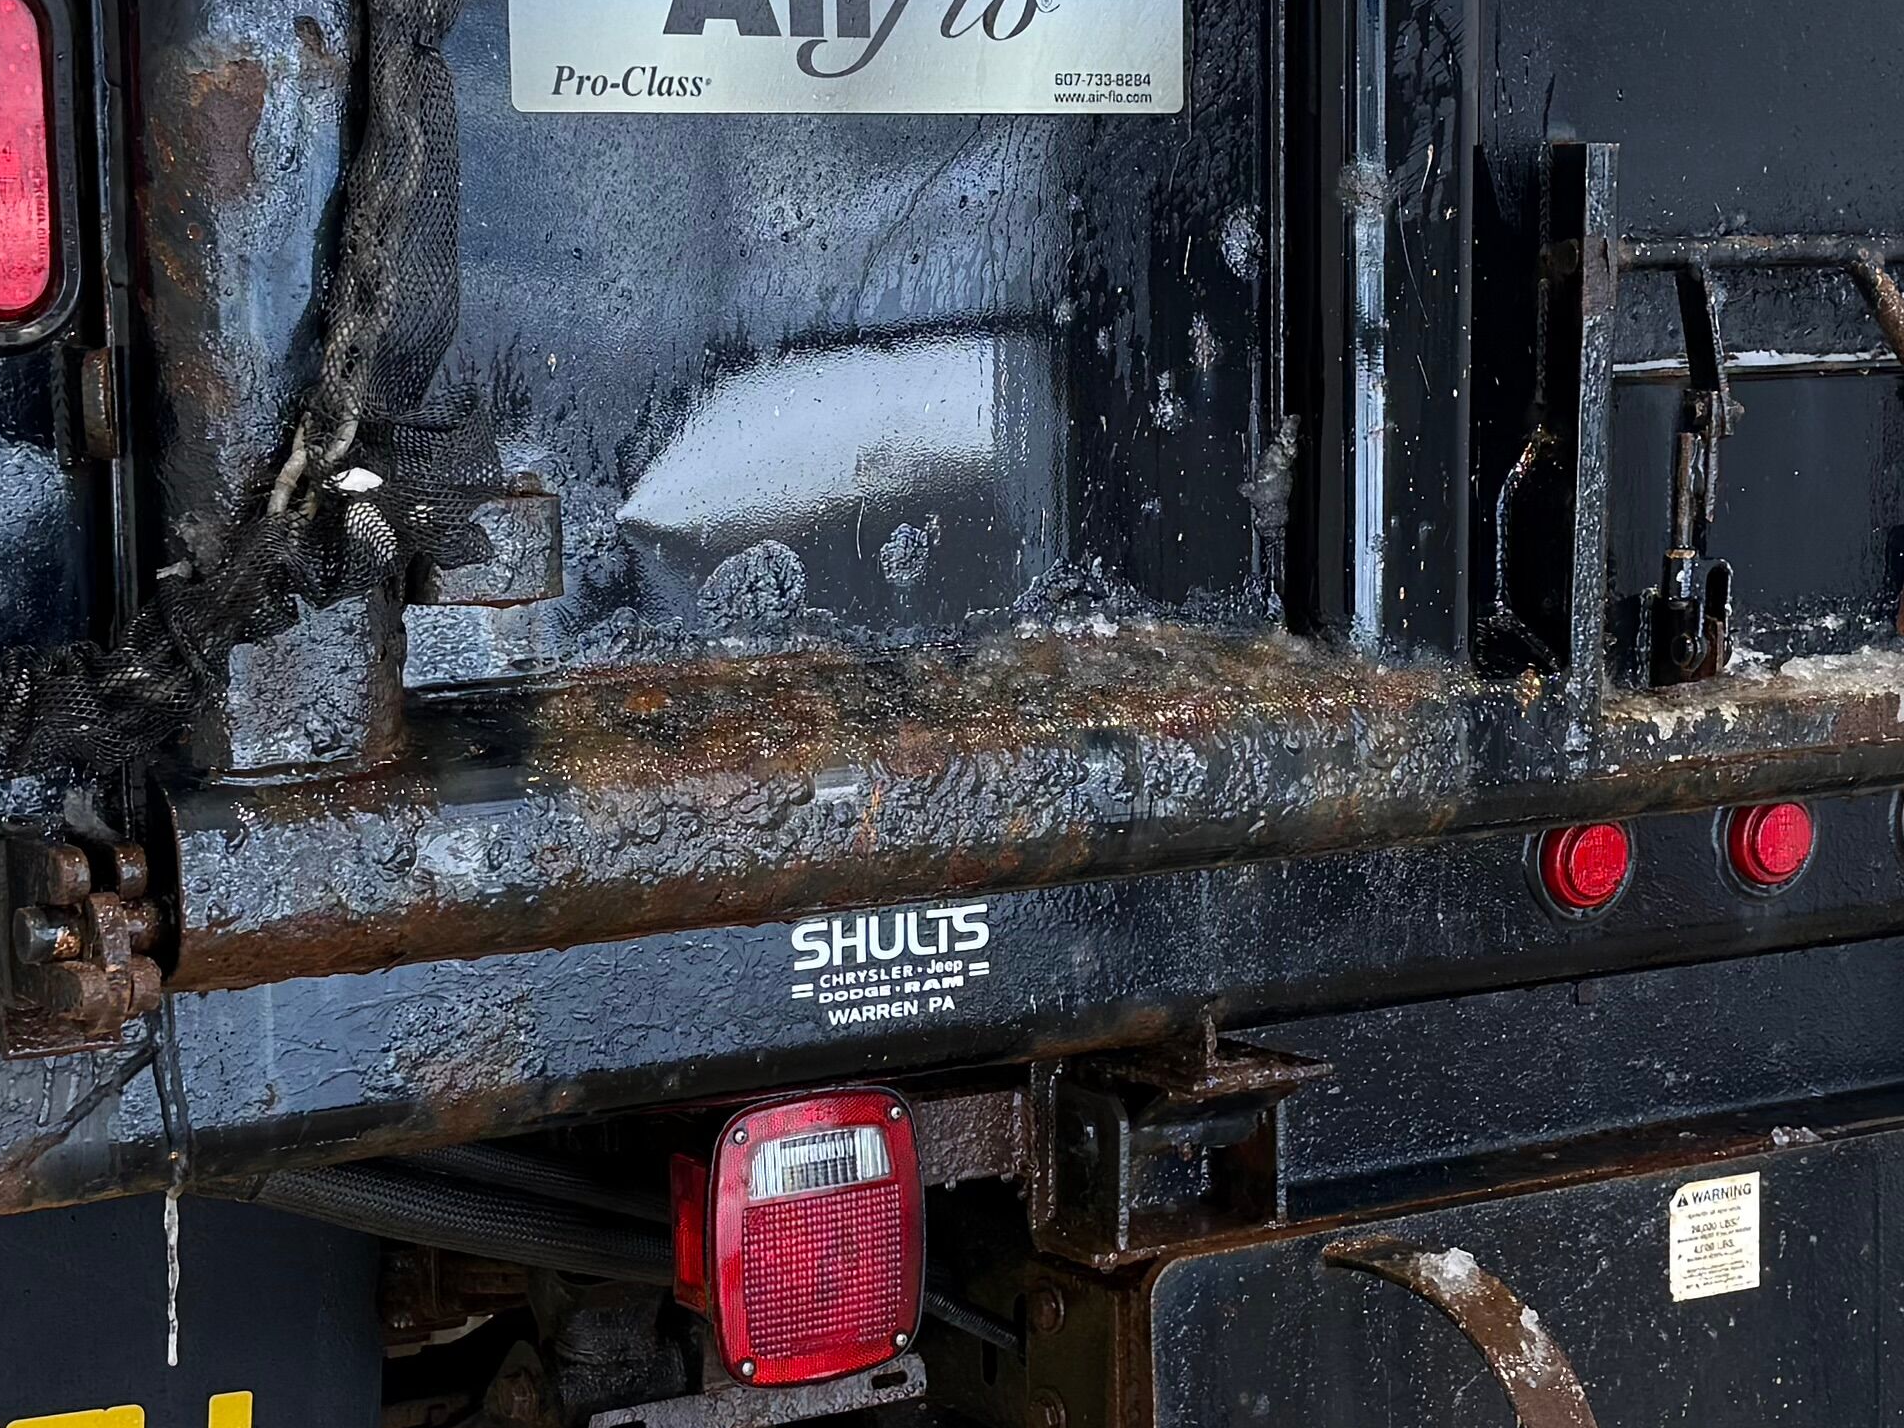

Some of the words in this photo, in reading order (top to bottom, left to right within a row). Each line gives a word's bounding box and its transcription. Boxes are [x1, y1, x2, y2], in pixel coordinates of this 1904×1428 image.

[551, 65, 704, 97] Pro-Class
[1054, 73, 1151, 86] 607-733-8284
[1054, 90, 1152, 103] www.air-flo.com
[791, 903, 990, 972] SHULTS
[819, 964, 914, 988] CHRYSLER
[926, 959, 963, 974] Jeep
[818, 984, 892, 1004] DODGE
[904, 975, 965, 994] RAM
[828, 999, 919, 1025] WARREN
[929, 995, 956, 1013] PA
[1691, 1183, 1752, 1204] WARNING
